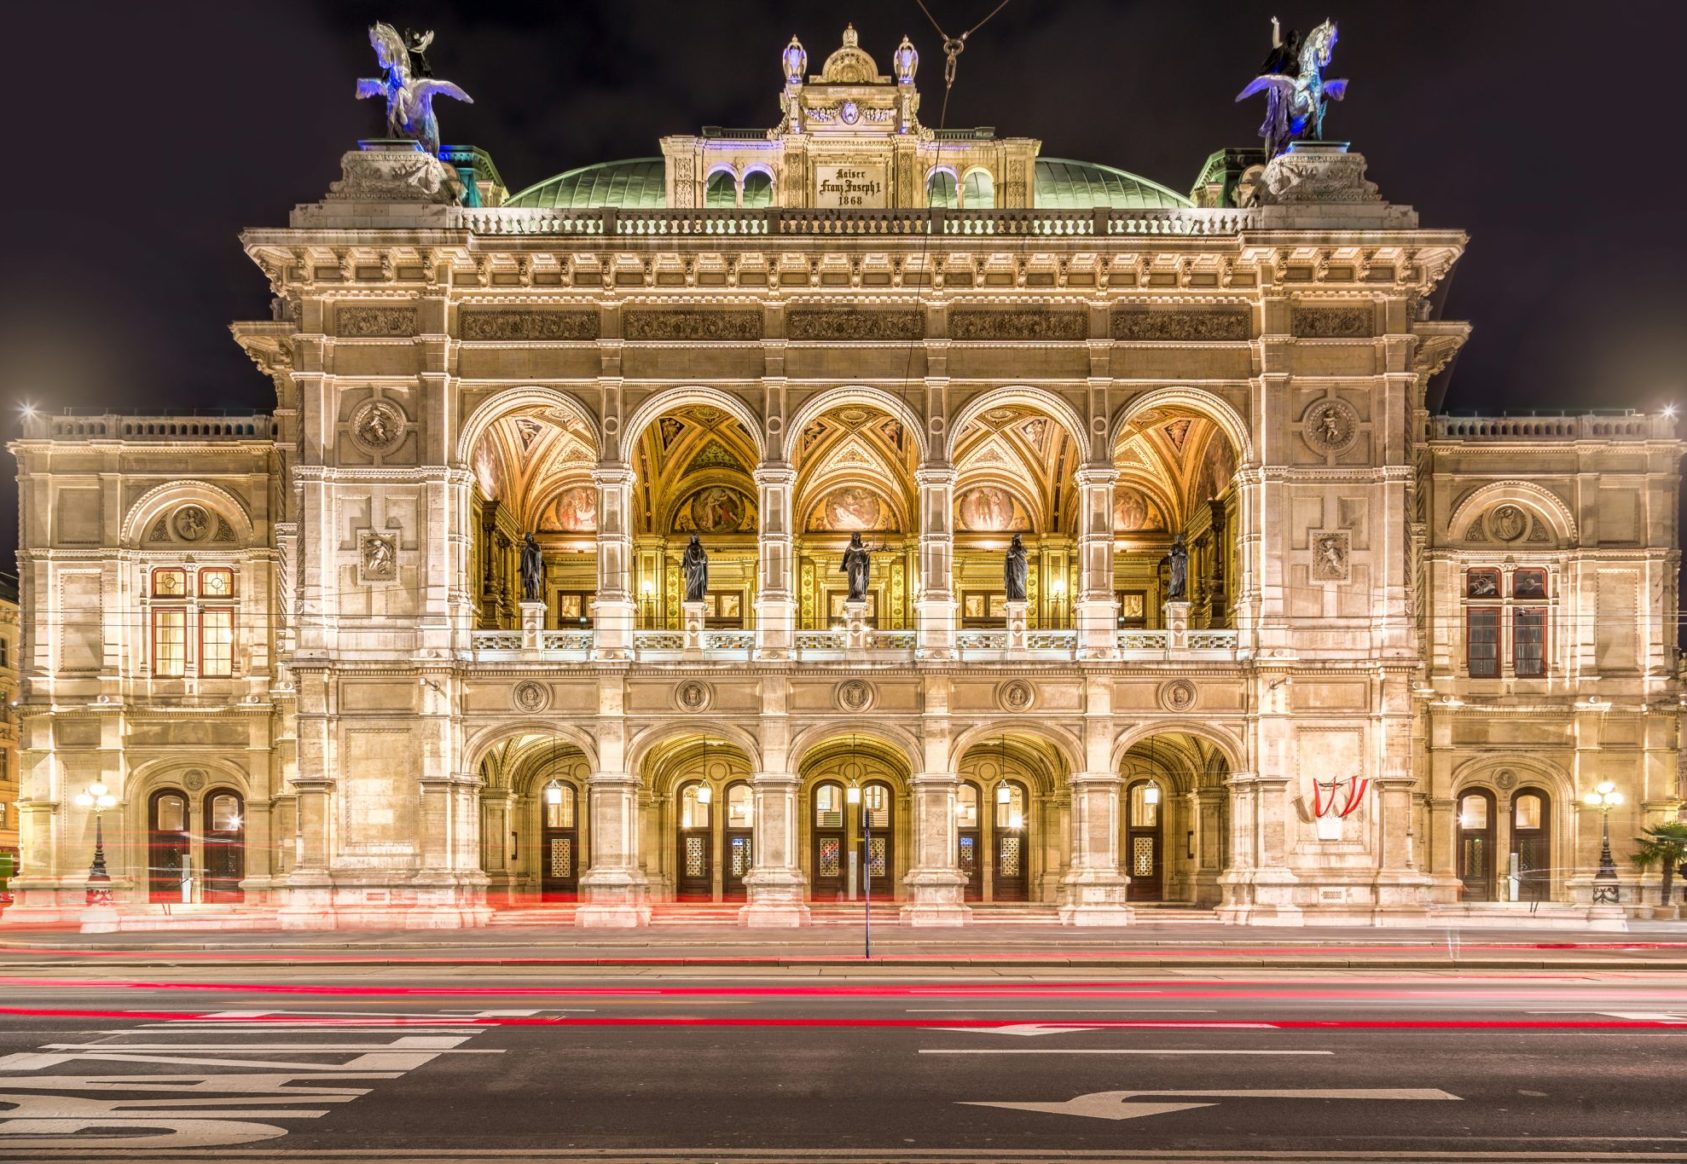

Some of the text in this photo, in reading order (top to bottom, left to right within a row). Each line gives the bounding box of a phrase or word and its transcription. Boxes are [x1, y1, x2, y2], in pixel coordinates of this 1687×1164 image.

[836, 169, 866, 179] Kaiser
[819, 179, 844, 195] Franz
[845, 179, 875, 196] Joseph
[839, 196, 863, 206] 1868
